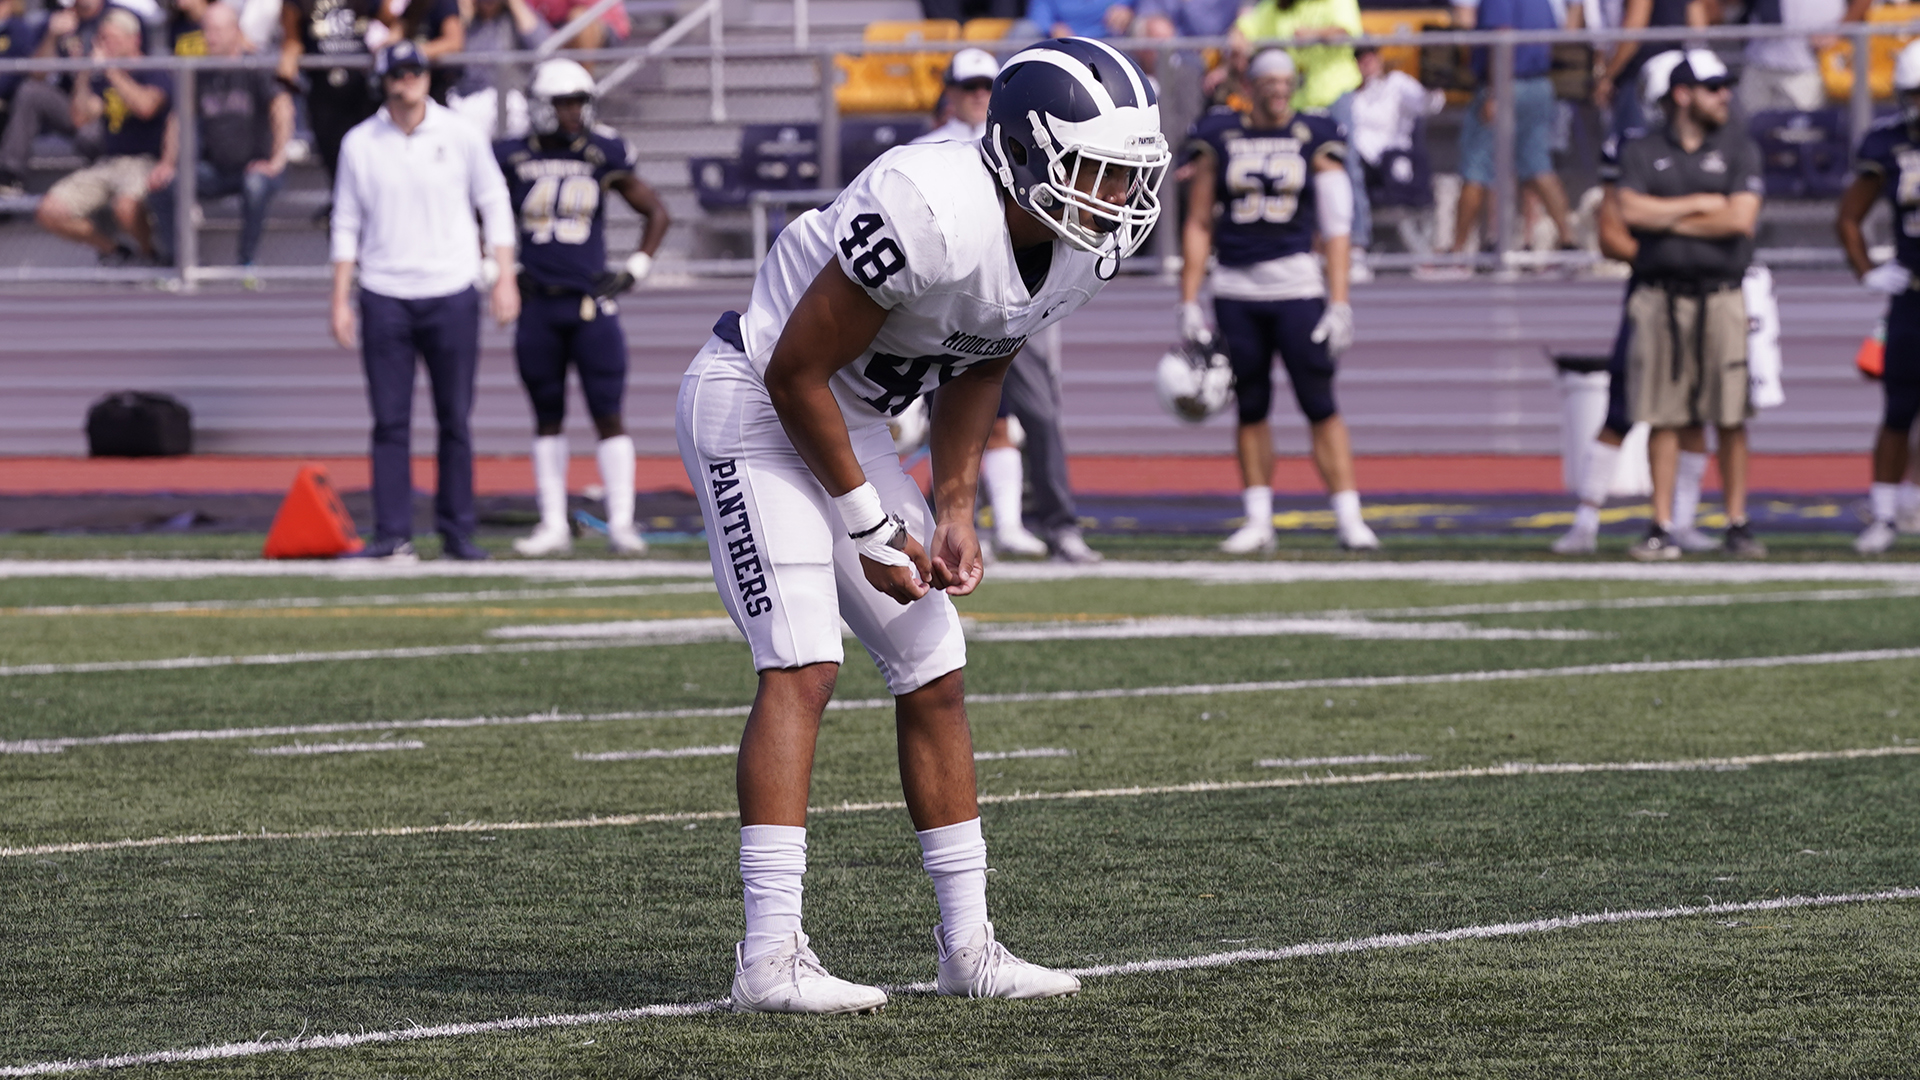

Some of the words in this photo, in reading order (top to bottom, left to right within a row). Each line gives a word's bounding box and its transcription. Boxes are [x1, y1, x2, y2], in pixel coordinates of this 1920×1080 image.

[1226, 152, 1306, 224] 53
[839, 213, 906, 289] 48
[709, 459, 773, 618] PANTHERS
